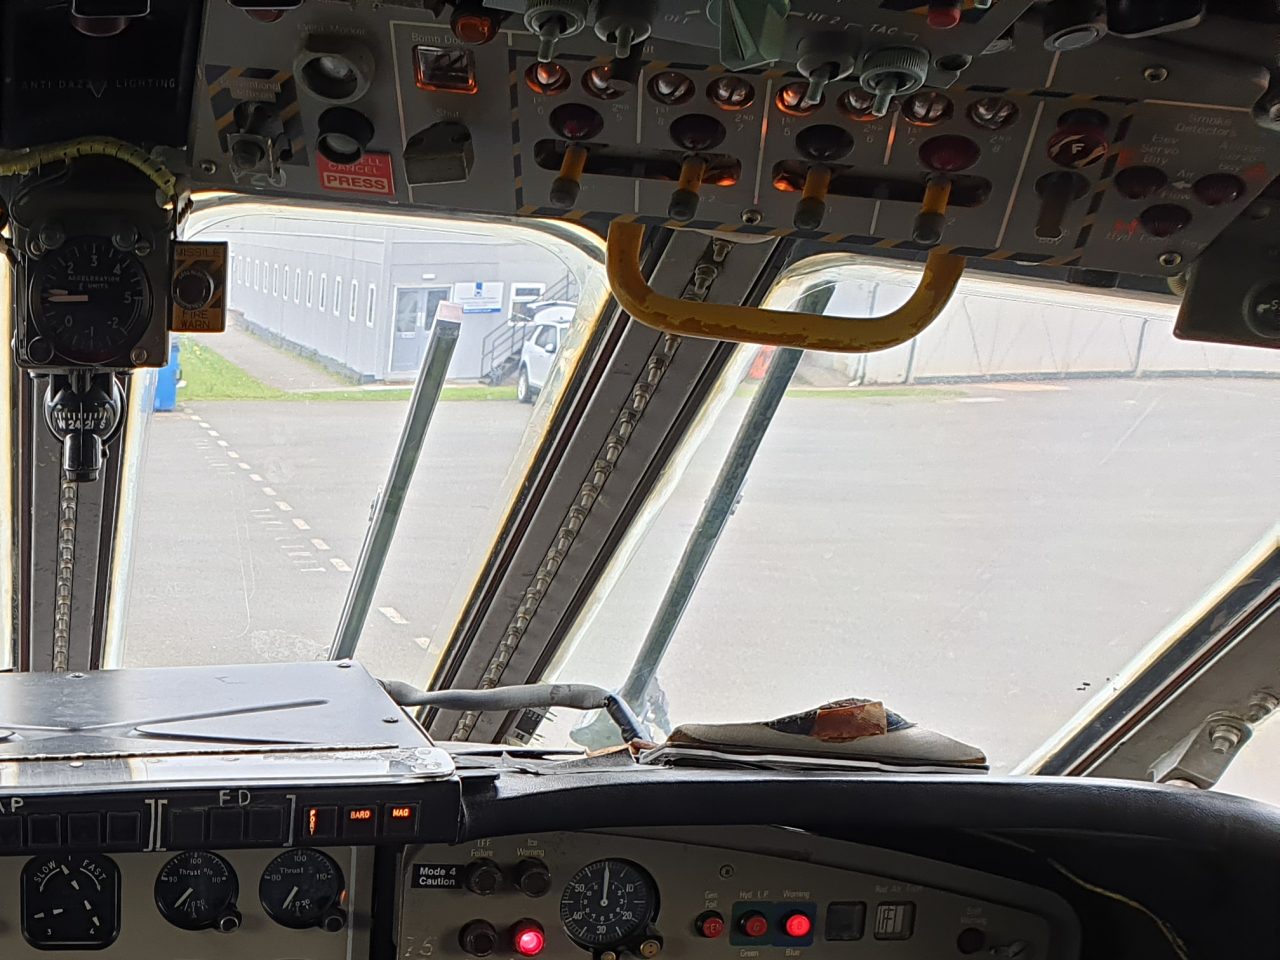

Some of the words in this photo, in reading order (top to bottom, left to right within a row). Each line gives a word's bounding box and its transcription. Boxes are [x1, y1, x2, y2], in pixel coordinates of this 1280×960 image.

[867, 23, 900, 36] TAC
[116, 78, 176, 89] LIGHTING
[1175, 123, 1238, 137] Detectors
[1140, 144, 1181, 155] Servo
[327, 162, 379, 175] CANCEL
[325, 175, 386, 191] PRESS
[176, 247, 220, 257] MISSILE
[181, 309, 209, 320] FIRE
[181, 319, 211, 330] WARN
[67, 418, 82, 430] 24
[391, 807, 410, 817] MAG
[32, 859, 59, 884] SLOW
[81, 857, 108, 882] FAST
[178, 867, 202, 877] Thrust
[280, 866, 305, 875] Thrust
[419, 866, 447, 877] Mode
[448, 866, 457, 877] 4
[418, 877, 456, 887] Caution
